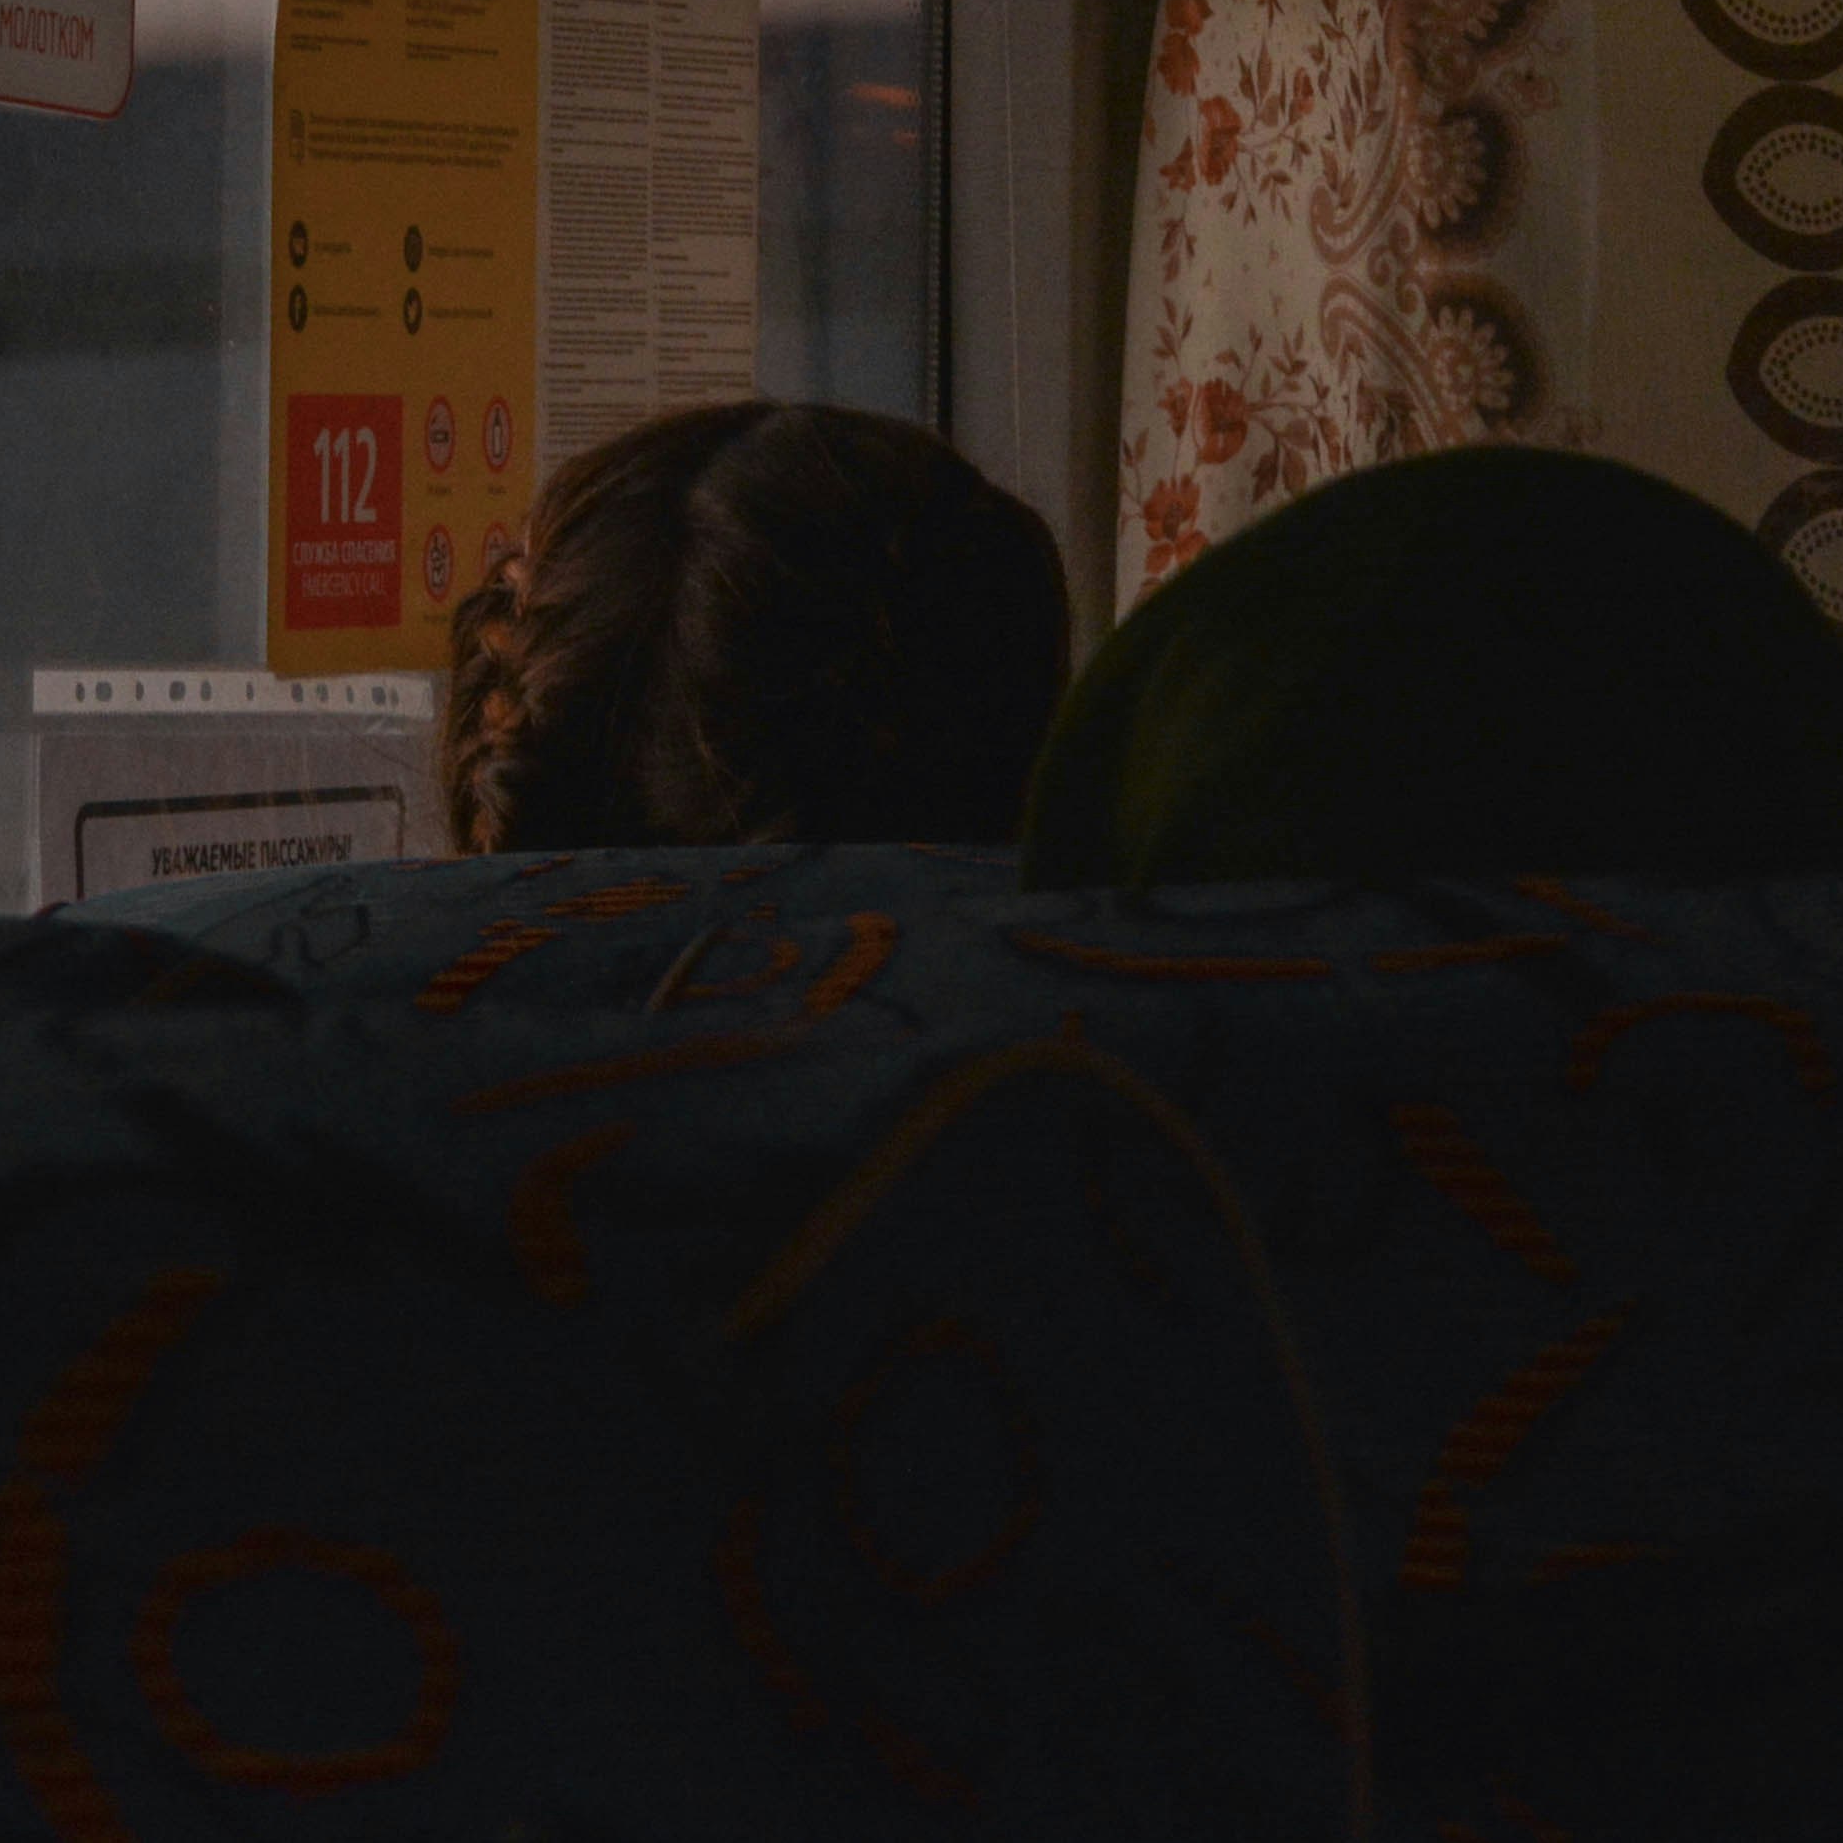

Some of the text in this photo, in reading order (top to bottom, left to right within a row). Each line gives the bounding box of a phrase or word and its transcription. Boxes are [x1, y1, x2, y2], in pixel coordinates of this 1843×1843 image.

[0, 4, 95, 61] МОЛОТКОМ
[314, 424, 378, 525] 112
[152, 834, 353, 877] УВАЖАЕМЫЕ ПАССАЖИРЫ!
